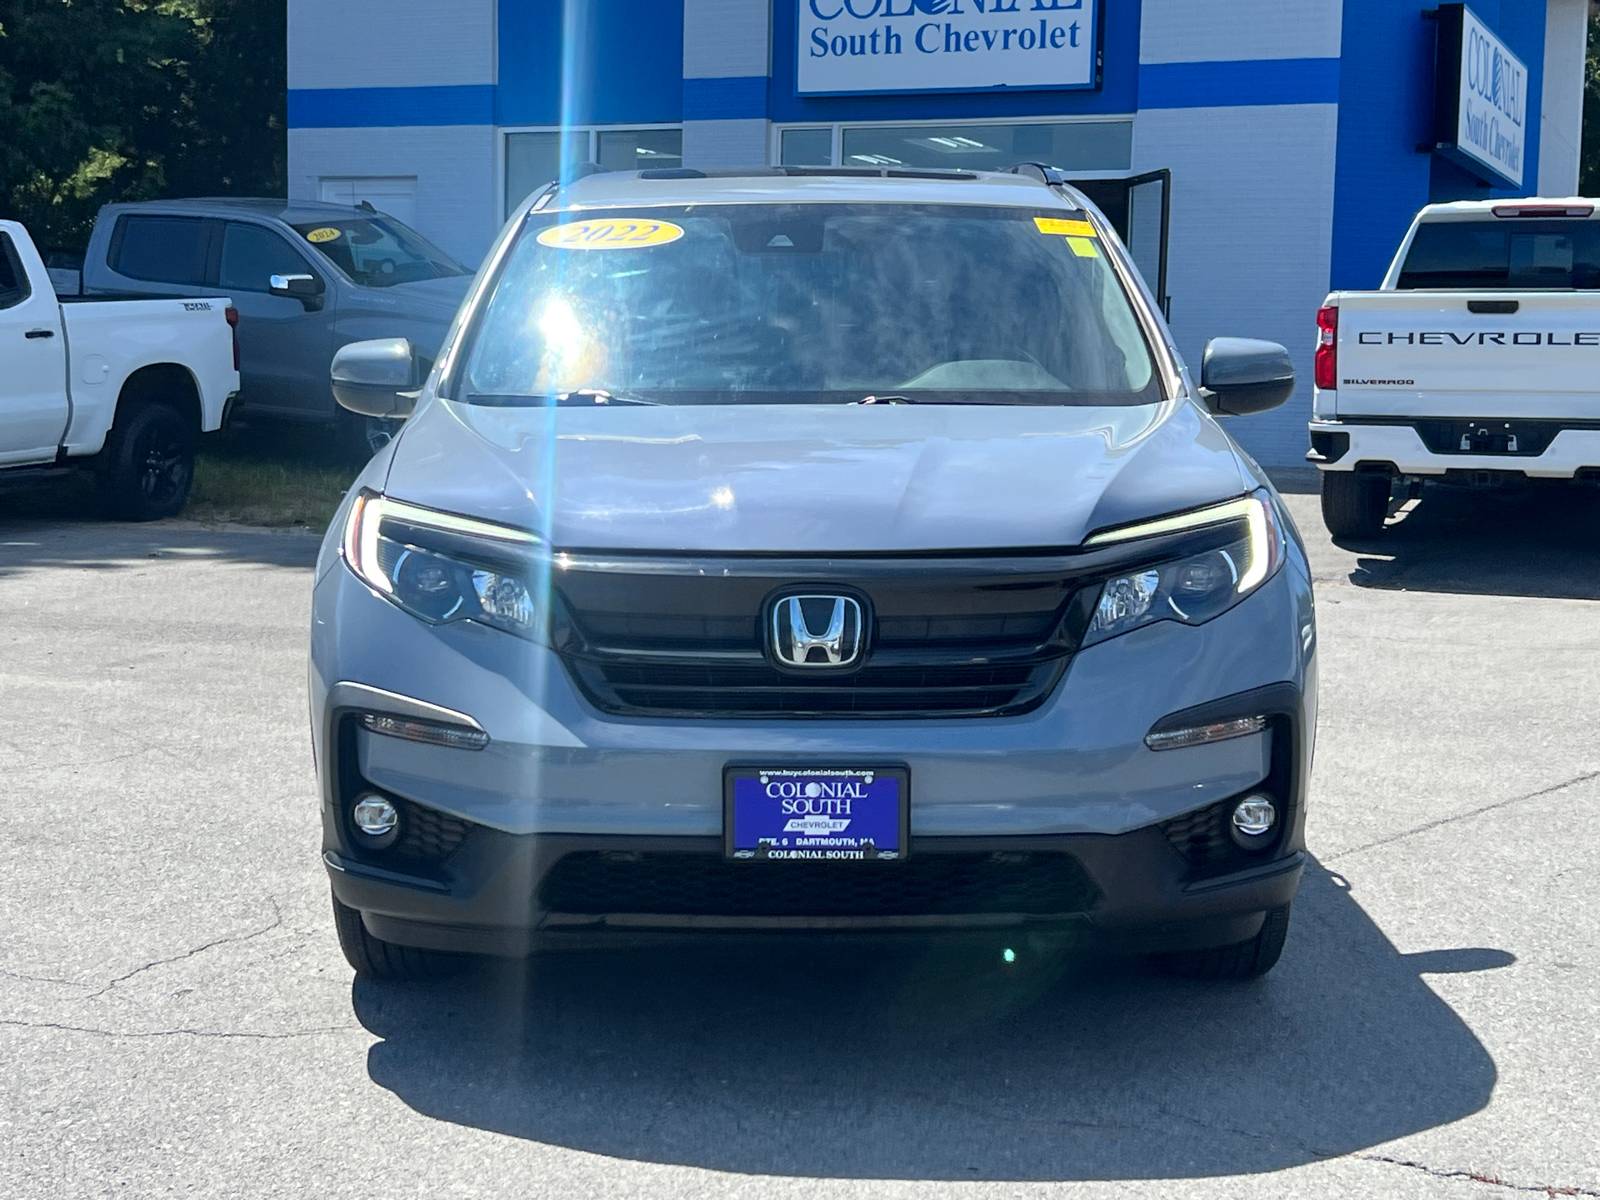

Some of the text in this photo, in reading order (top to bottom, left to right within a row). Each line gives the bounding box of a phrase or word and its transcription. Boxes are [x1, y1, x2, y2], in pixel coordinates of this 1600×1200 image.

[810, 19, 1081, 57] South Chevrolet
[1469, 27, 1521, 127] COLONIAL
[1465, 98, 1520, 173] South Chevrolet
[563, 225, 660, 243] 2022
[759, 769, 874, 778] www.buycolonialsouth.com
[766, 782, 868, 798] COLONIAL
[782, 799, 851, 815] SOUTH
[790, 821, 844, 829] CHEVROLET
[796, 838, 857, 847] DARTMOUTH,
[768, 850, 864, 859] COLONIAL SOUTH
